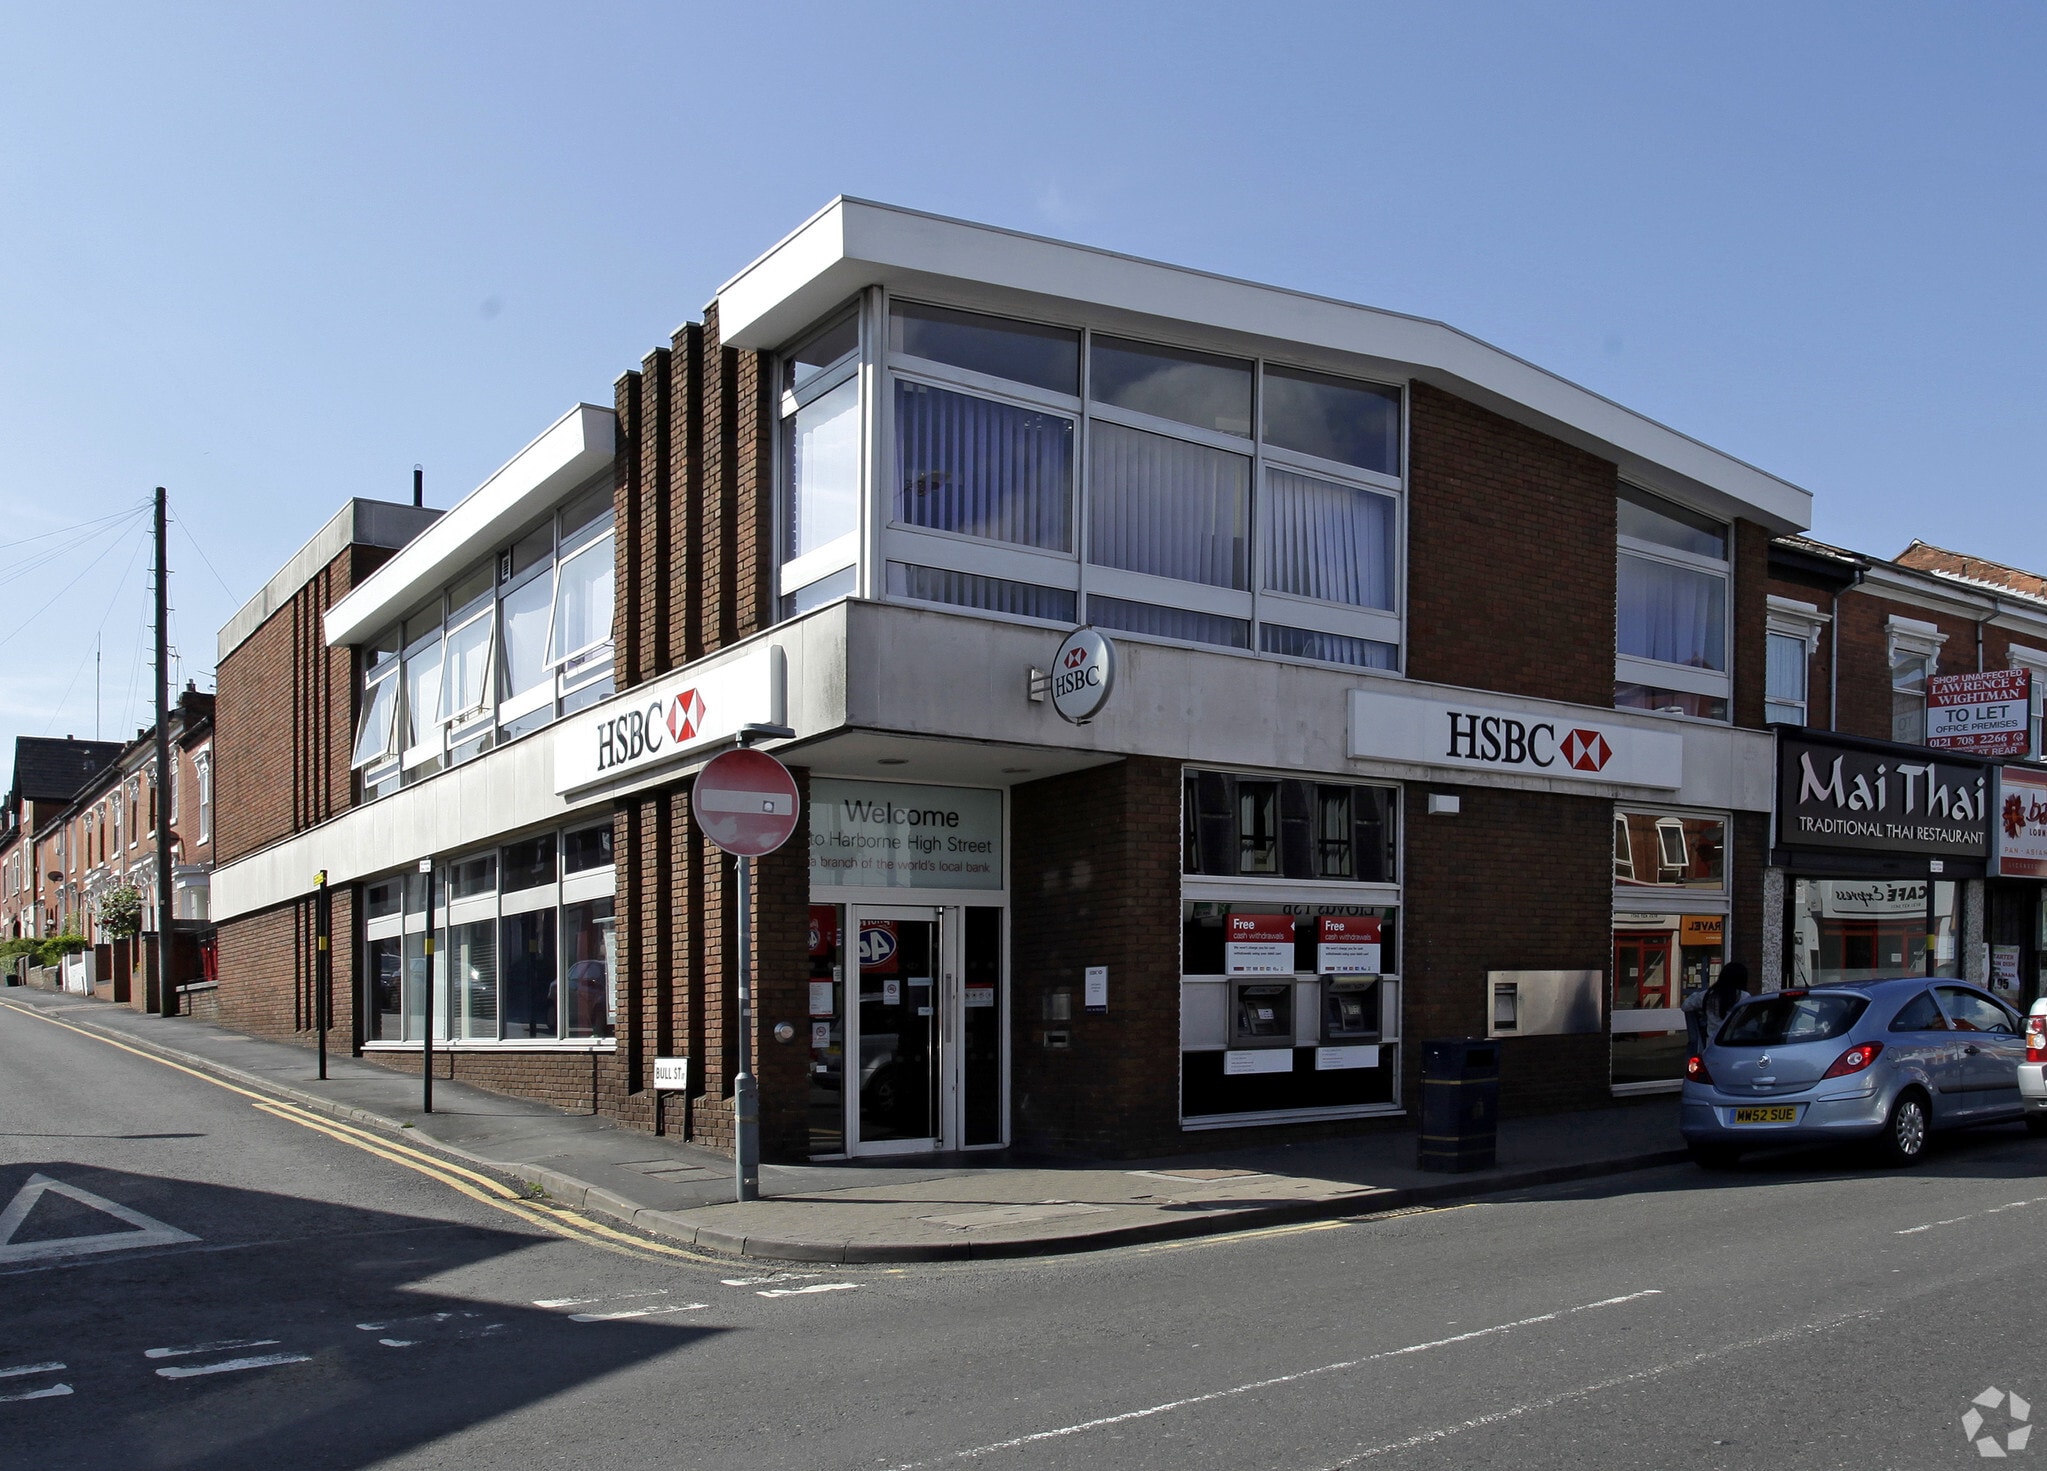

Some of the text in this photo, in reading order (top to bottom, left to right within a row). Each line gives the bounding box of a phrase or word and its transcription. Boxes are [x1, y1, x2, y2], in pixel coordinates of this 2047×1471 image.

[1055, 665, 1100, 698] HSBC
[1933, 669, 2023, 684] SHOP UNAFFECTED
[1931, 677, 2026, 695] LAWRENCE &
[1937, 688, 2020, 705] WIGHTMAN
[1945, 705, 2010, 722] TO LET
[597, 699, 663, 771] HSBC
[1936, 719, 2018, 734] OFFICE PREMISES
[1446, 711, 1555, 768] HSBC
[1929, 737, 1951, 748] 0121
[1957, 736, 1975, 745] 708
[1980, 733, 2008, 744] 2266
[1992, 746, 2018, 755] REAR
[1800, 751, 1985, 821] Mai Thai
[845, 799, 960, 828] Welcome
[1799, 816, 1985, 845] TRADITIONAL THAI RESTAURANT
[810, 831, 992, 854] to Harborne High Street
[810, 856, 991, 873] a branch of the world's local bank
[1233, 918, 1255, 930] Free
[1325, 920, 1345, 931] Free
[1233, 932, 1285, 940] cash withdrawals
[1325, 933, 1372, 941] cash withdrawals
[656, 1067, 672, 1079] BULL
[674, 1067, 682, 1079] ST
[1770, 1108, 1794, 1120] SUE
